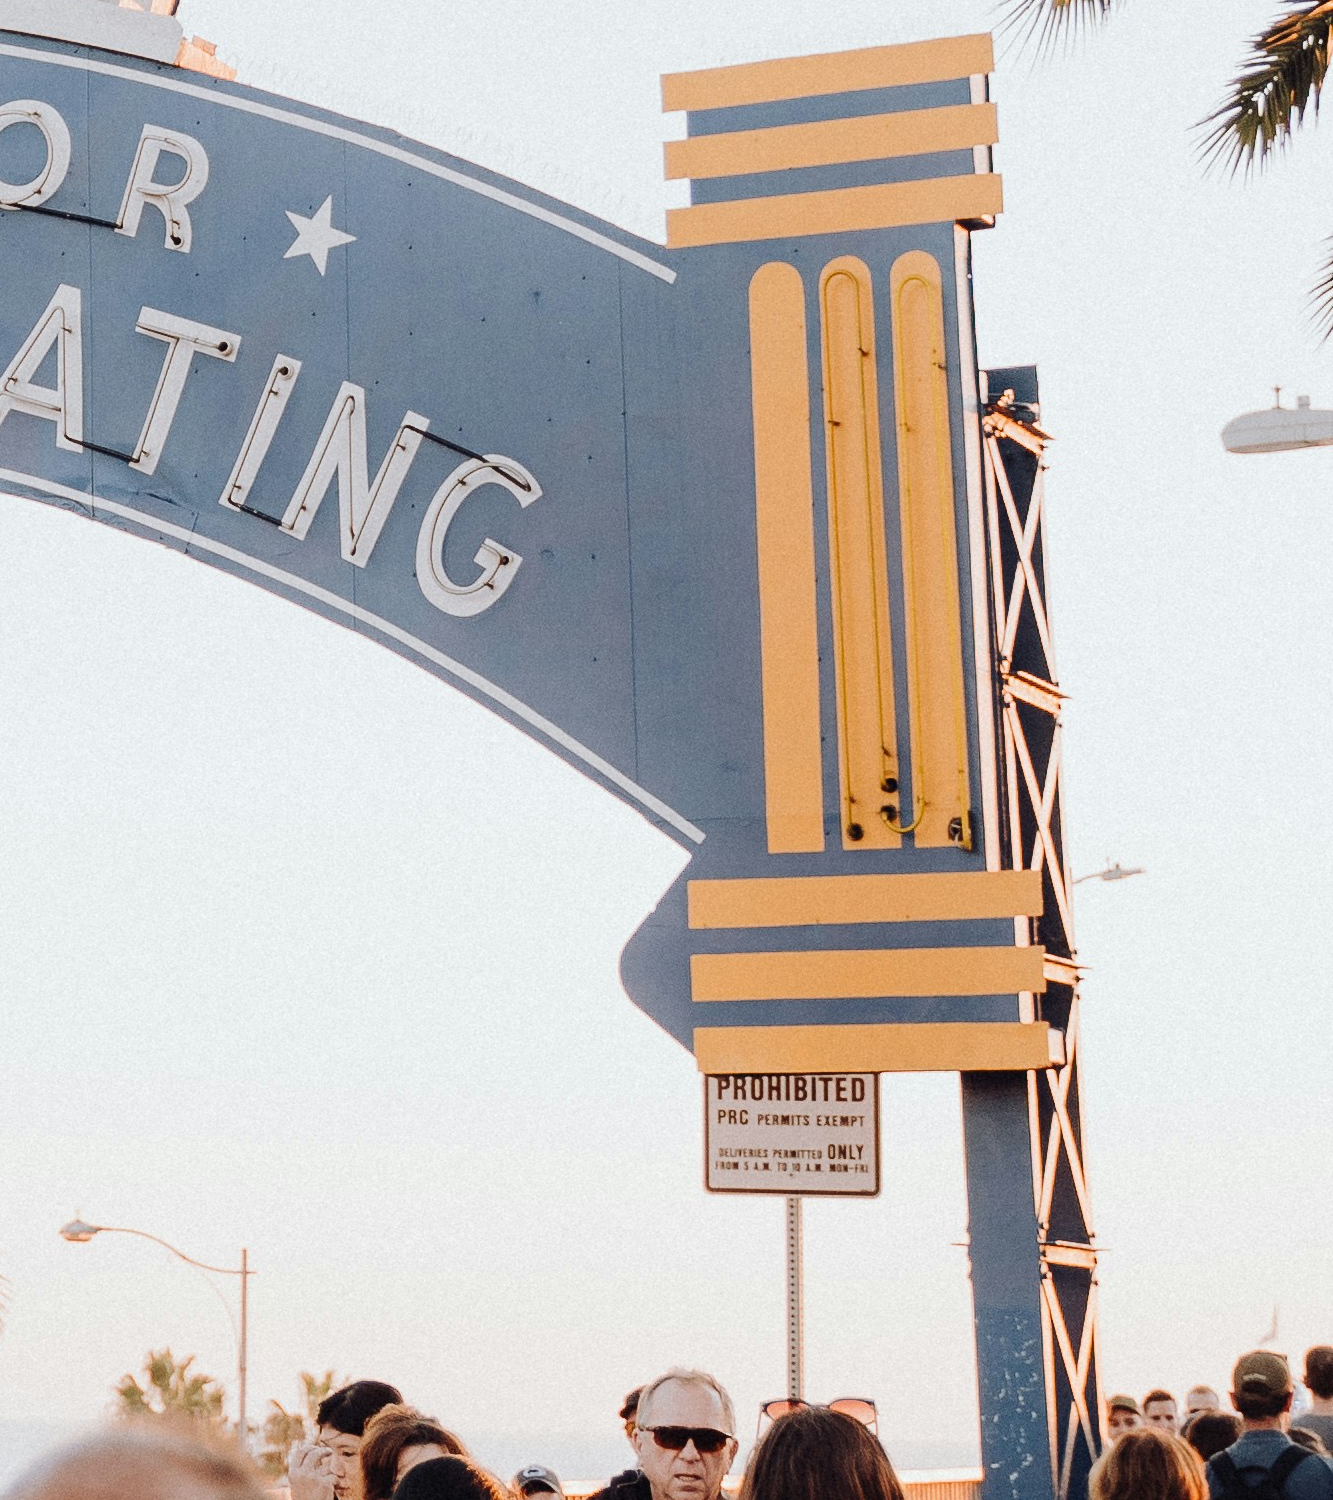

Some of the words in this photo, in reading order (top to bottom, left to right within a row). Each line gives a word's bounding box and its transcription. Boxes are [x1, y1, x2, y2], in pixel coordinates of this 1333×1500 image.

[717, 1075, 866, 1102] PROHIBITED
[717, 1109, 749, 1125] PRC
[757, 1113, 810, 1127] PERMITS
[816, 1114, 866, 1128] EXEMPT
[718, 1148, 768, 1158] DELIVERIES
[772, 1149, 823, 1160] PERMITTED
[827, 1143, 865, 1161] ONLY
[715, 1160, 739, 1170] FROM
[777, 1162, 788, 1172] TO
[829, 1163, 869, 1174] MON-FRI
